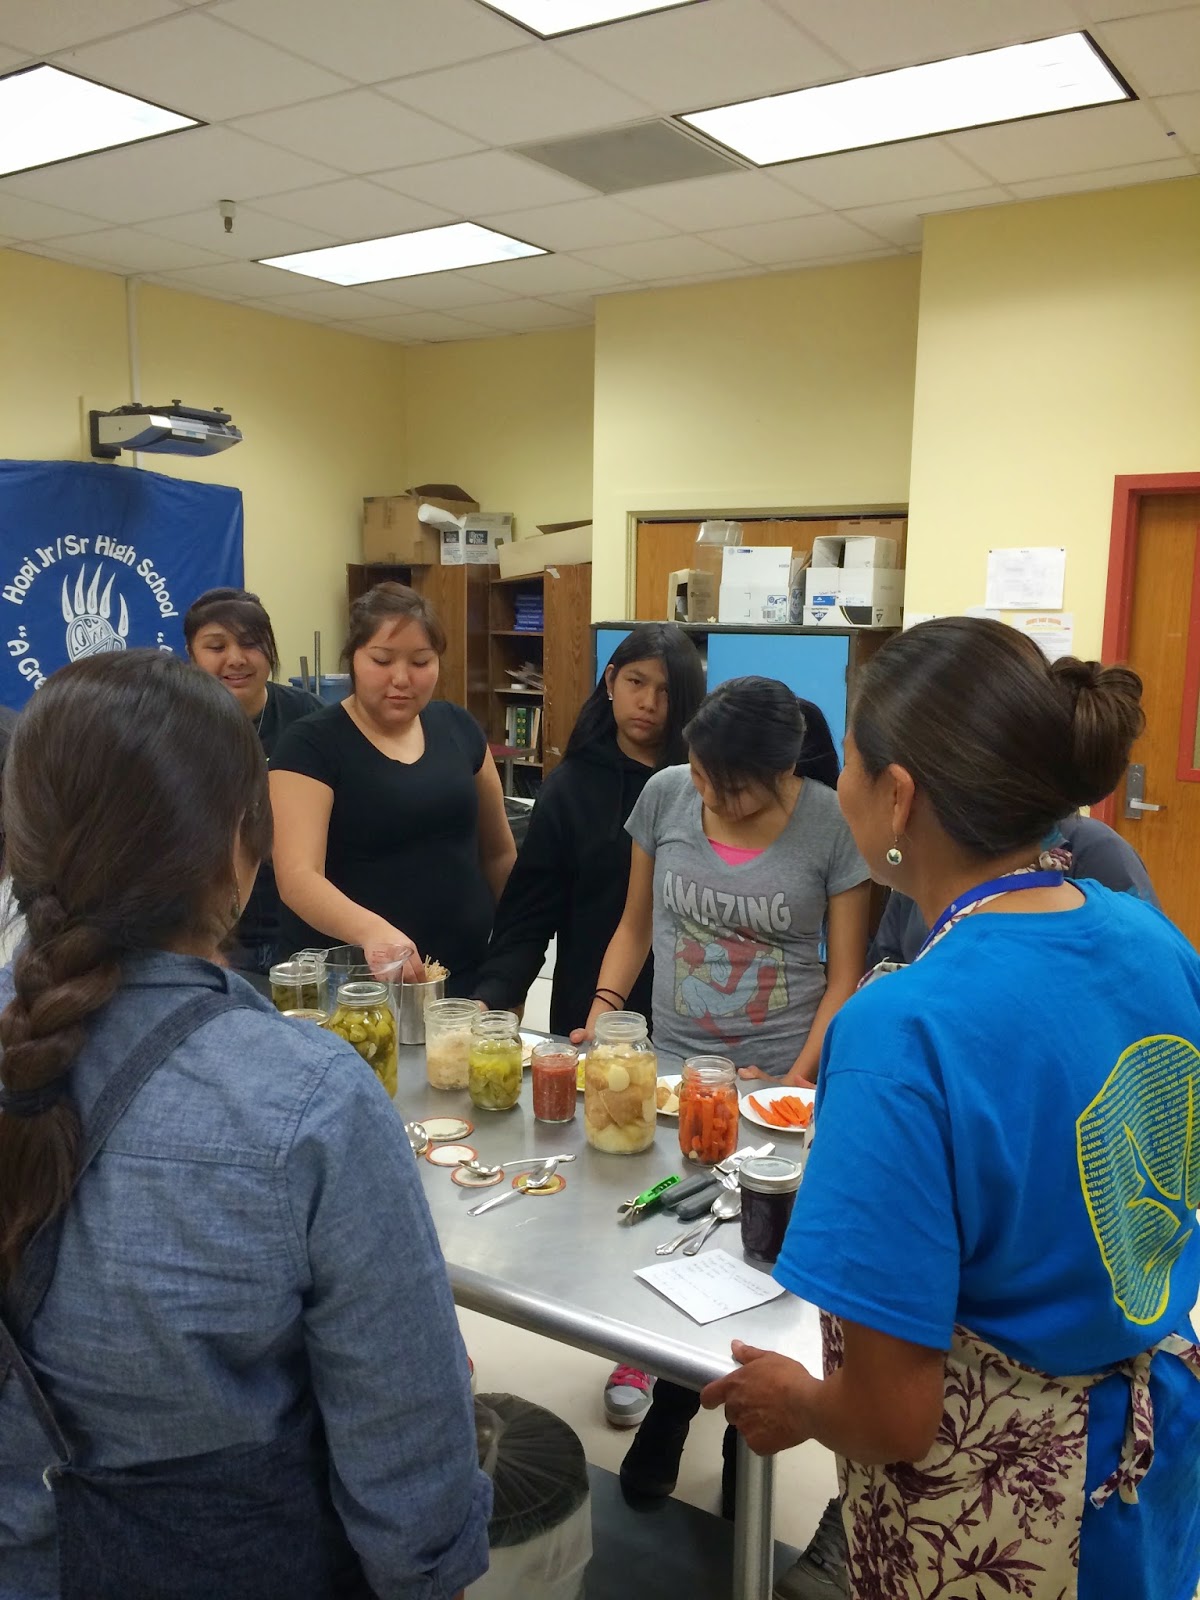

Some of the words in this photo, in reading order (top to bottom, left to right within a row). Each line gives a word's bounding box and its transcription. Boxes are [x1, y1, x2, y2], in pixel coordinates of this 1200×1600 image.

[2, 557, 41, 605] Hopi
[95, 535, 137, 567] High
[136, 558, 179, 618] School
[18, 657, 48, 691] Gre
[663, 870, 792, 934] AMAZING
